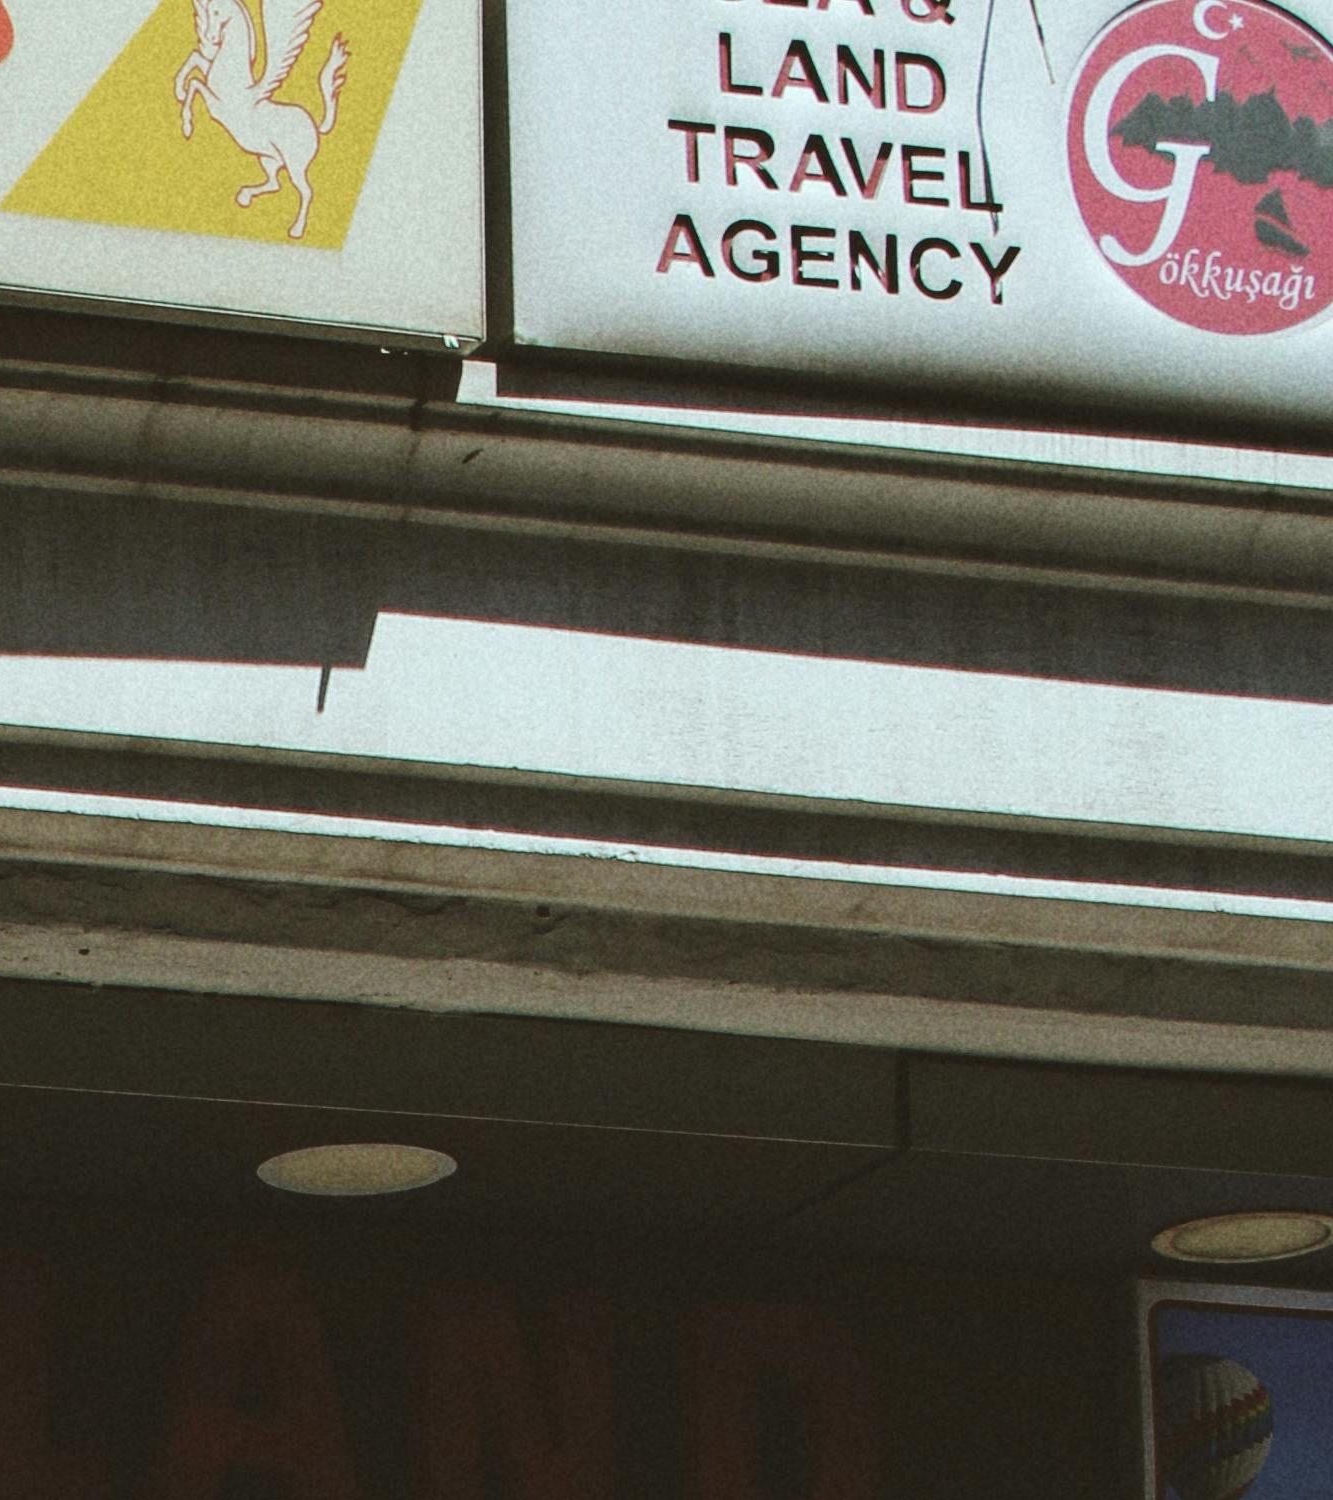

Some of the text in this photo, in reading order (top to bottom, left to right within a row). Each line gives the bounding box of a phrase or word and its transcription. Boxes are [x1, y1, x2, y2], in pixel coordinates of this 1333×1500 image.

[719, 32, 946, 114] LAND
[667, 119, 1003, 213] TRAVEL
[657, 213, 1021, 305] AGENCY
